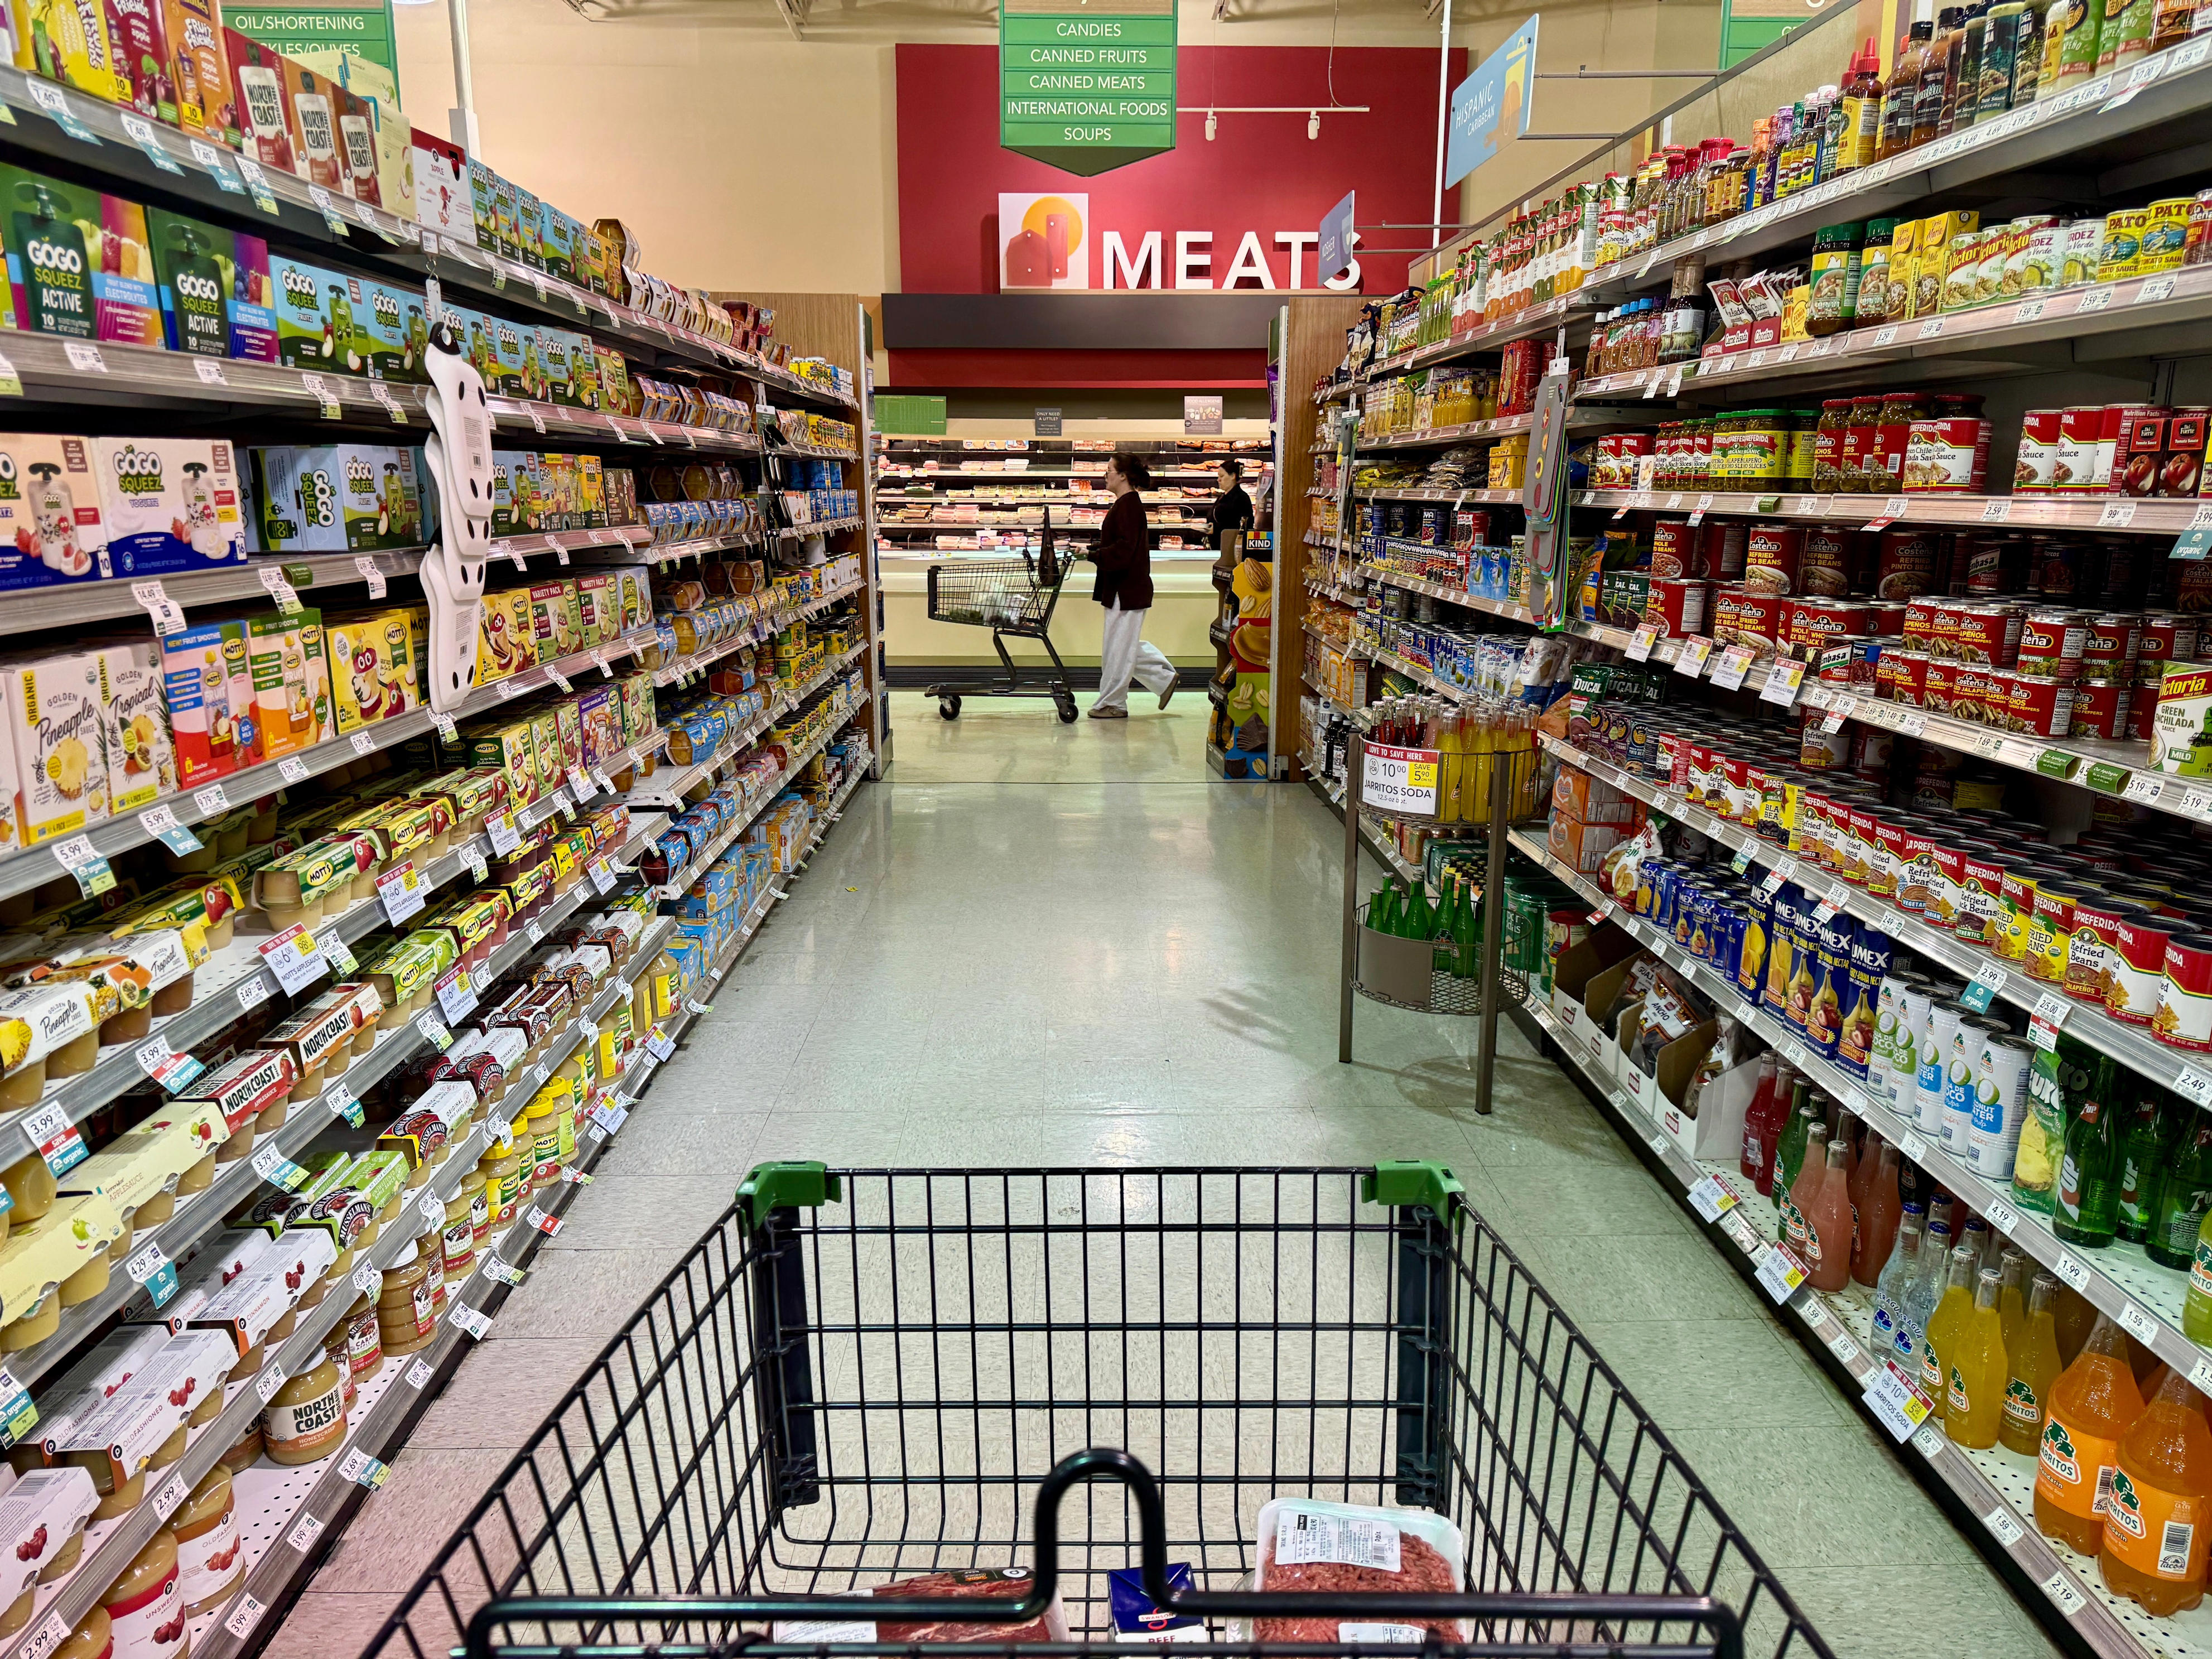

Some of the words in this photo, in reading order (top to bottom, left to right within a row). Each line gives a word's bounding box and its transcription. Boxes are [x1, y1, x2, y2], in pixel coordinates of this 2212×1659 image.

[235, 16, 364, 30] OIL/SHORTENING
[1057, 23, 1121, 37] CANDIES
[1030, 49, 1094, 62] CANNED
[1099, 50, 1147, 63] FRUITS
[2175, 52, 2192, 66] 3.09
[1029, 75, 1093, 88] CANNED
[1098, 76, 1145, 89] MEATS
[247, 85, 273, 104] NORTH
[189, 107, 197, 118] 10
[1007, 102, 1116, 115] INTERNATIONAL
[1120, 103, 1167, 115] FOODS
[1456, 80, 1493, 129] HISPANIC
[252, 106, 277, 127] COAST
[1468, 104, 1495, 136] CARIBBEAN
[1064, 128, 1111, 141] SOUPS
[2108, 214, 2147, 232] PATO
[1322, 236, 1336, 257] KOSHER
[105, 287, 148, 305] ELECTROLYTES
[42, 313, 54, 326] 10
[1755, 330, 1774, 344] Chorizo
[1876, 333, 1890, 342] 3.29
[2022, 450, 2044, 459] Sauce
[1986, 507, 2002, 515] 2.59
[1249, 539, 1271, 548] KIND
[1750, 542, 1781, 551] Costeña
[2176, 544, 2203, 556] organic
[138, 589, 156, 599] 14.49
[532, 588, 548, 599] VARIETY
[550, 585, 561, 595] PACK
[302, 628, 321, 639] MOTT'S
[1809, 620, 1846, 632] Costeña
[224, 644, 245, 654] MOTT'S
[1574, 678, 1602, 693] DUCAL
[27, 675, 37, 722] ORGANIC
[47, 692, 78, 707] GOLDEN
[109, 676, 154, 720] Tropical
[2161, 705, 2186, 716] GREEN
[35, 696, 95, 755] Pineapple
[80, 726, 95, 735] SAUCE
[1369, 745, 1380, 756] LOVE
[1381, 747, 1388, 756] TO
[1390, 749, 1404, 759] SAVE
[1407, 751, 1425, 761] HERE.
[2171, 749, 2192, 761] MILD
[1365, 778, 1399, 795] JARRITOS
[1400, 787, 1432, 799] SODA
[2128, 780, 2145, 793] 5.19
[146, 813, 164, 827] 5.99
[60, 844, 81, 860] 5.99
[309, 864, 332, 885] MOTT'S
[2070, 941, 2105, 959] Refried
[151, 944, 176, 977] Tropical
[297, 953, 321, 973] APPLESAUCE
[2070, 952, 2099, 968] Beans
[402, 966, 419, 984] MOTT'S
[1981, 967, 1998, 981] 2.99
[2066, 982, 2096, 995] JALAPEÑOS
[1964, 994, 1984, 1009] organic
[40, 999, 78, 1039] Pineapple
[1652, 1001, 1670, 1021] ANCHO
[2039, 1018, 2050, 1029] save
[303, 1028, 327, 1059] NORTH
[327, 1010, 349, 1041] COAST
[141, 1045, 160, 1064] 3.99
[163, 1057, 178, 1072] save
[180, 1063, 200, 1082] organic
[225, 1081, 253, 1113] NORTH
[250, 1065, 276, 1093] COAST
[2181, 1074, 2206, 1091] 2.49
[254, 1087, 277, 1107] APPLESAUCE
[446, 1098, 464, 1117] ORIGINAL
[30, 1116, 54, 1136] 3.99
[62, 1147, 84, 1165] organic
[257, 1154, 272, 1171] 3.79
[109, 1173, 144, 1203] APPLESAUCE
[372, 1171, 396, 1197] UNSWEETENED
[339, 1203, 371, 1241] MUSSELMAN'S
[1992, 1205, 2009, 1222] 4.19
[131, 1257, 146, 1277] 4.29
[2063, 1259, 2081, 1277] 1.99
[157, 1279, 176, 1301] organic
[246, 1296, 271, 1321] CINNAMON
[2128, 1311, 2143, 1328] 1.59
[1893, 1368, 1903, 1378] LOVE
[1907, 1381, 1916, 1393] SAVE
[293, 1393, 335, 1421] NORTH
[1873, 1388, 1897, 1414] JARRITOS
[1894, 1412, 1910, 1430] SODA
[295, 1406, 336, 1434] COAST
[2005, 1415, 2024, 1428] Mango
[298, 1425, 336, 1444] HONEYCRISP
[1920, 1430, 1932, 1444] 1.59
[346, 1458, 359, 1475] 3.69
[157, 1485, 175, 1510] 2.99
[1994, 1515, 2009, 1530] 1.59
[2052, 1579, 2073, 1602] 2.19
[231, 1613, 247, 1633] 3.99
[26, 1629, 48, 1659] 2.99
